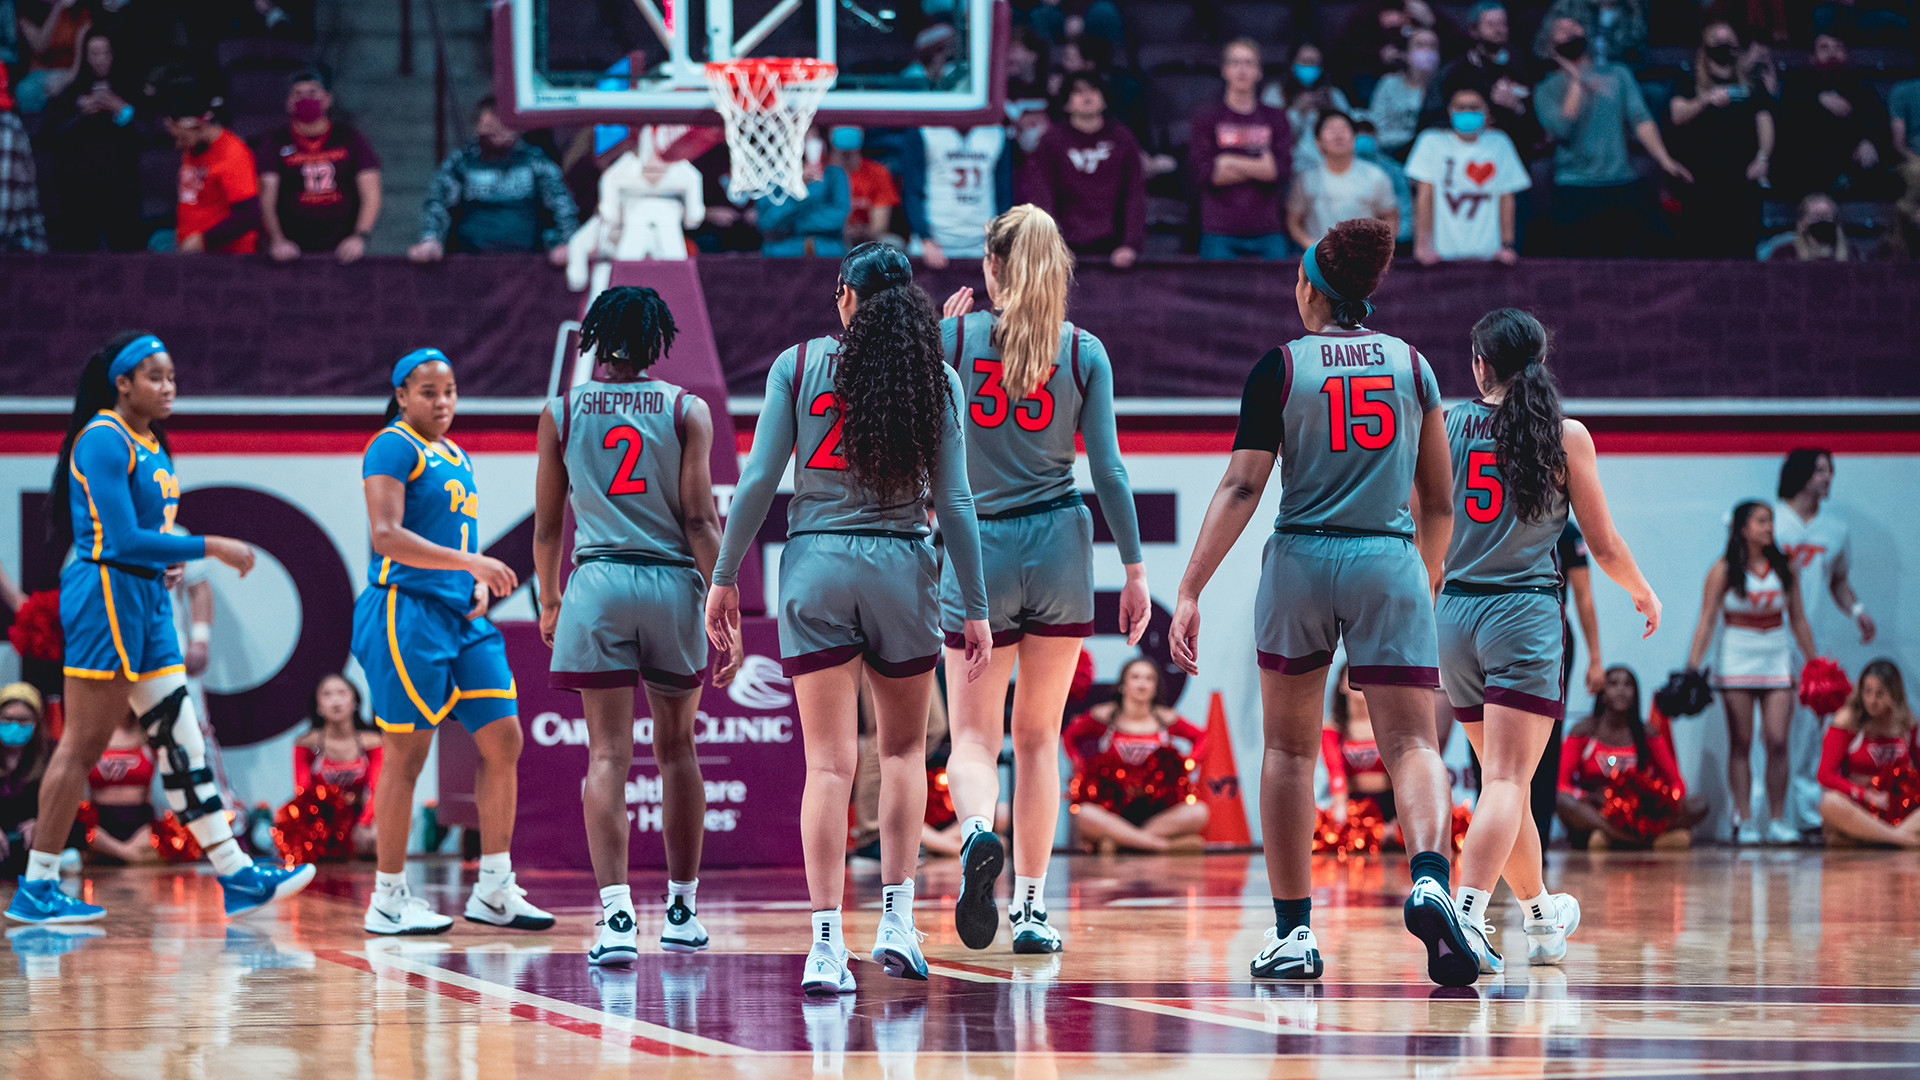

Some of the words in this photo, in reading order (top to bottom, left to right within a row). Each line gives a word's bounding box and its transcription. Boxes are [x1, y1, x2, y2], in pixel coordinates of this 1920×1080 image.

[1444, 157, 1455, 187] I
[1444, 191, 1492, 219] VT
[1320, 343, 1385, 367] BAINES
[581, 391, 664, 415] SHEPPARD
[969, 358, 1060, 432] 33
[1319, 374, 1397, 453] 15
[602, 423, 648, 497] 2
[1464, 449, 1507, 524] 5
[694, 710, 793, 744] CLINIC
[1208, 775, 1238, 799] VT
[1297, 931, 1309, 941] GT
